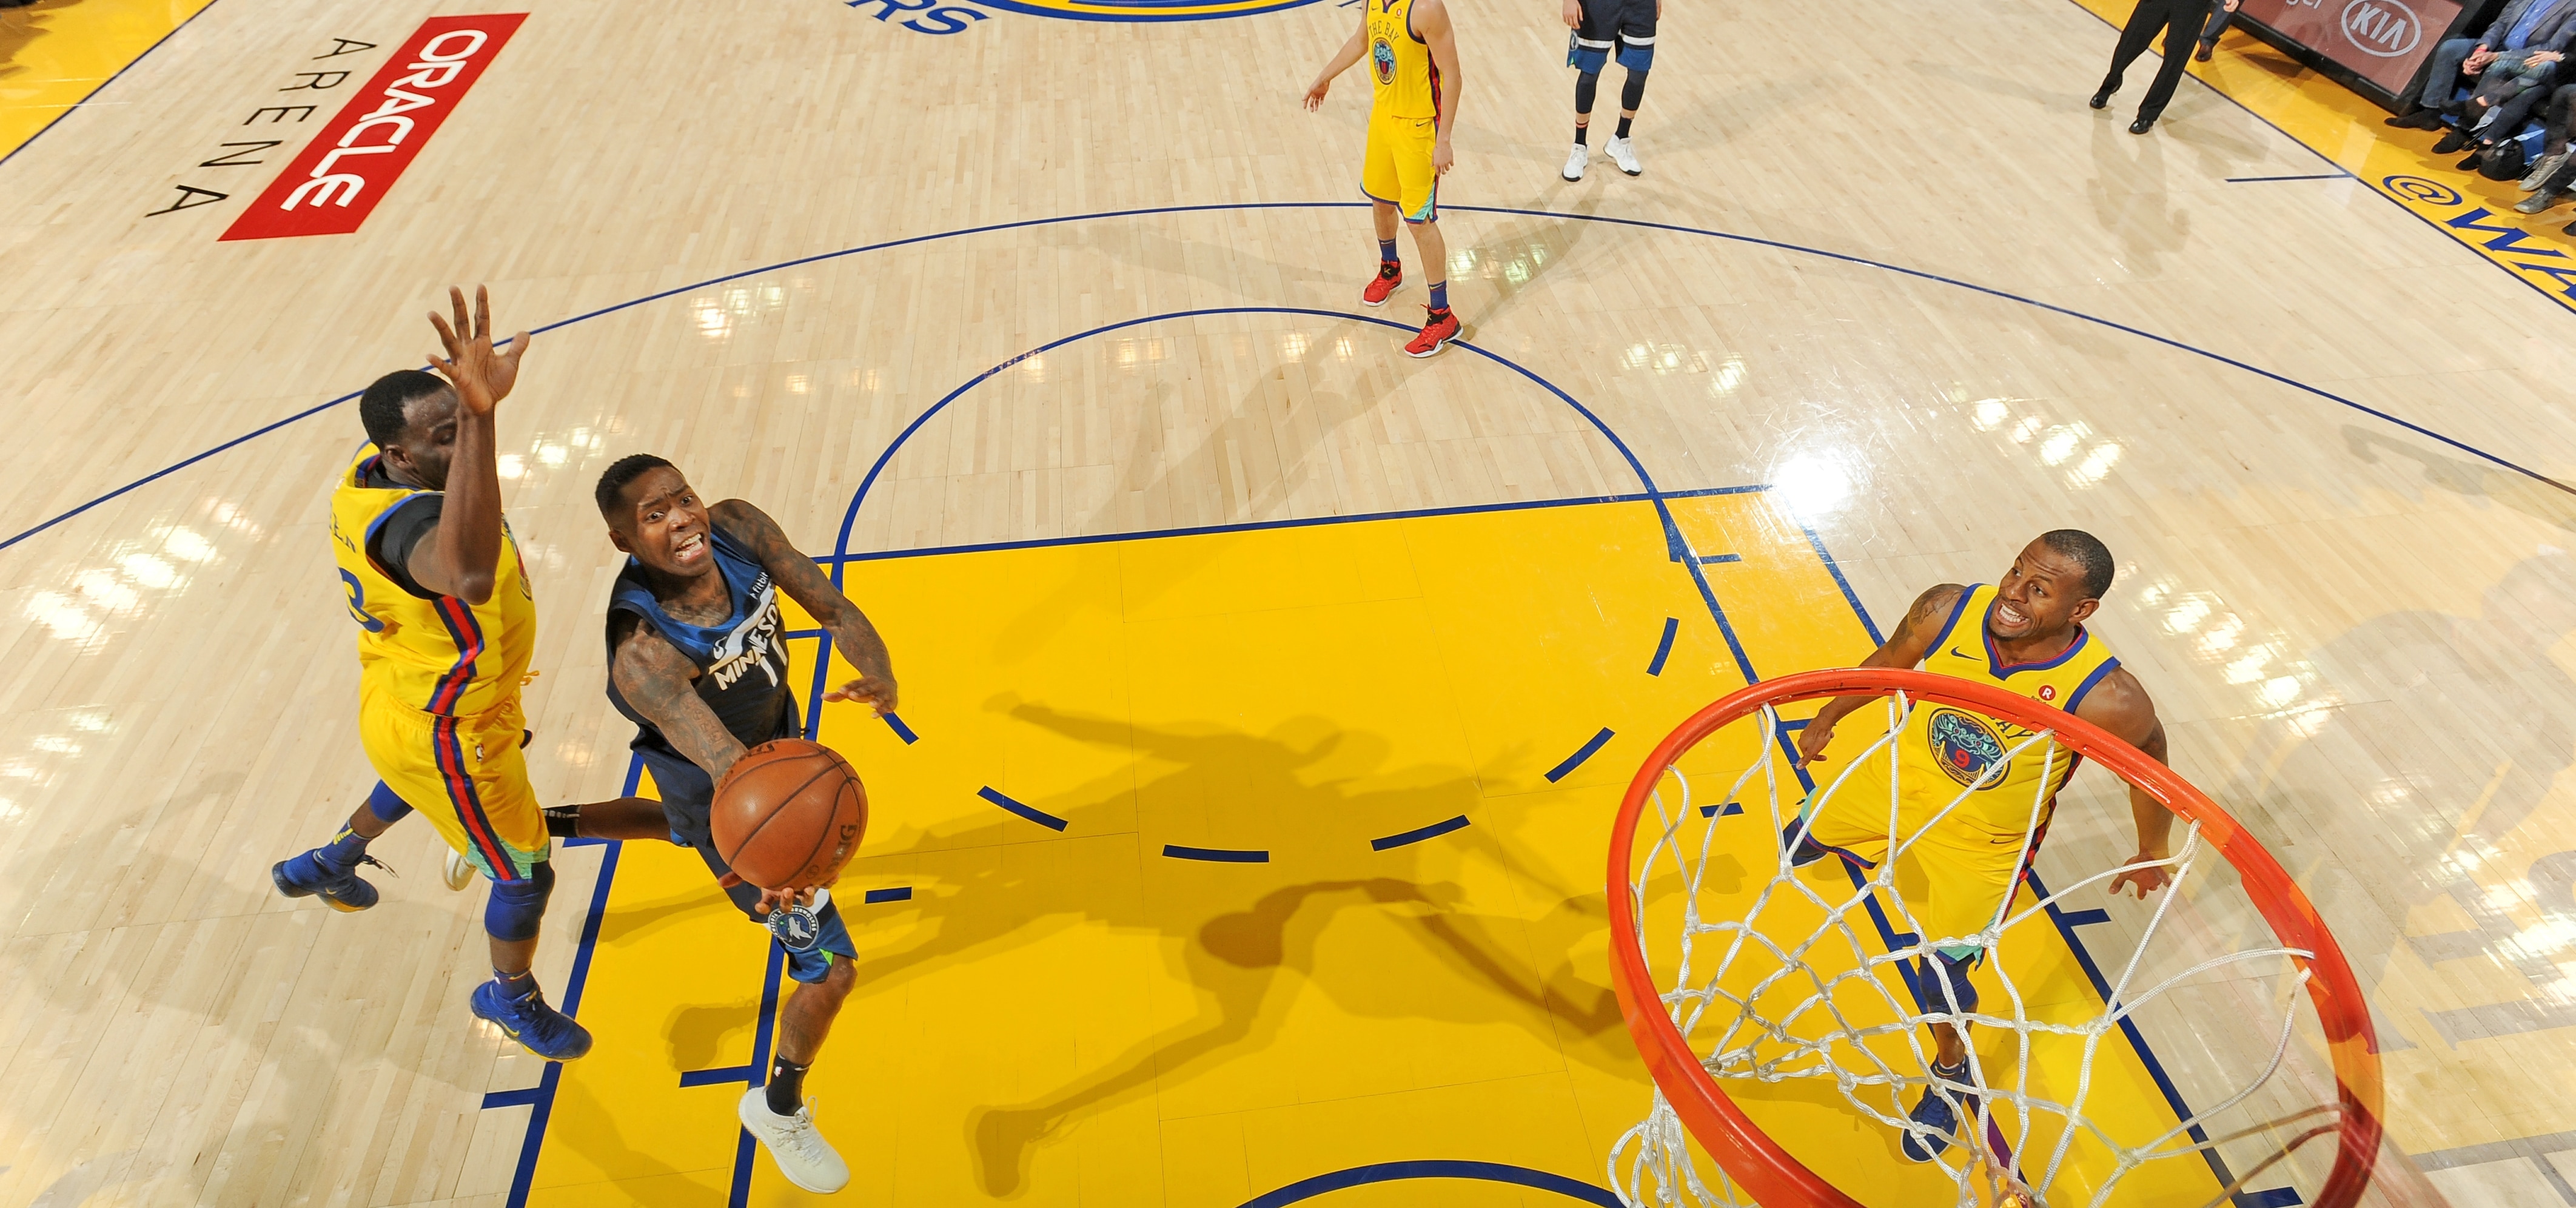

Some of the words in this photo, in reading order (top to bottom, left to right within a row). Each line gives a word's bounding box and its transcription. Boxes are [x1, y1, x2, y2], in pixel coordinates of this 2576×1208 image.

[1369, 20, 1382, 38] THE
[1384, 22, 1400, 43] BAY
[2350, 3, 2407, 50] KIA
[145, 38, 378, 217] ARENA
[280, 29, 488, 211] ORACLE
[752, 571, 769, 594] fitbit
[714, 599, 779, 691] MINNESO
[1990, 716, 2034, 740] AY
[1953, 749, 1970, 768] 9
